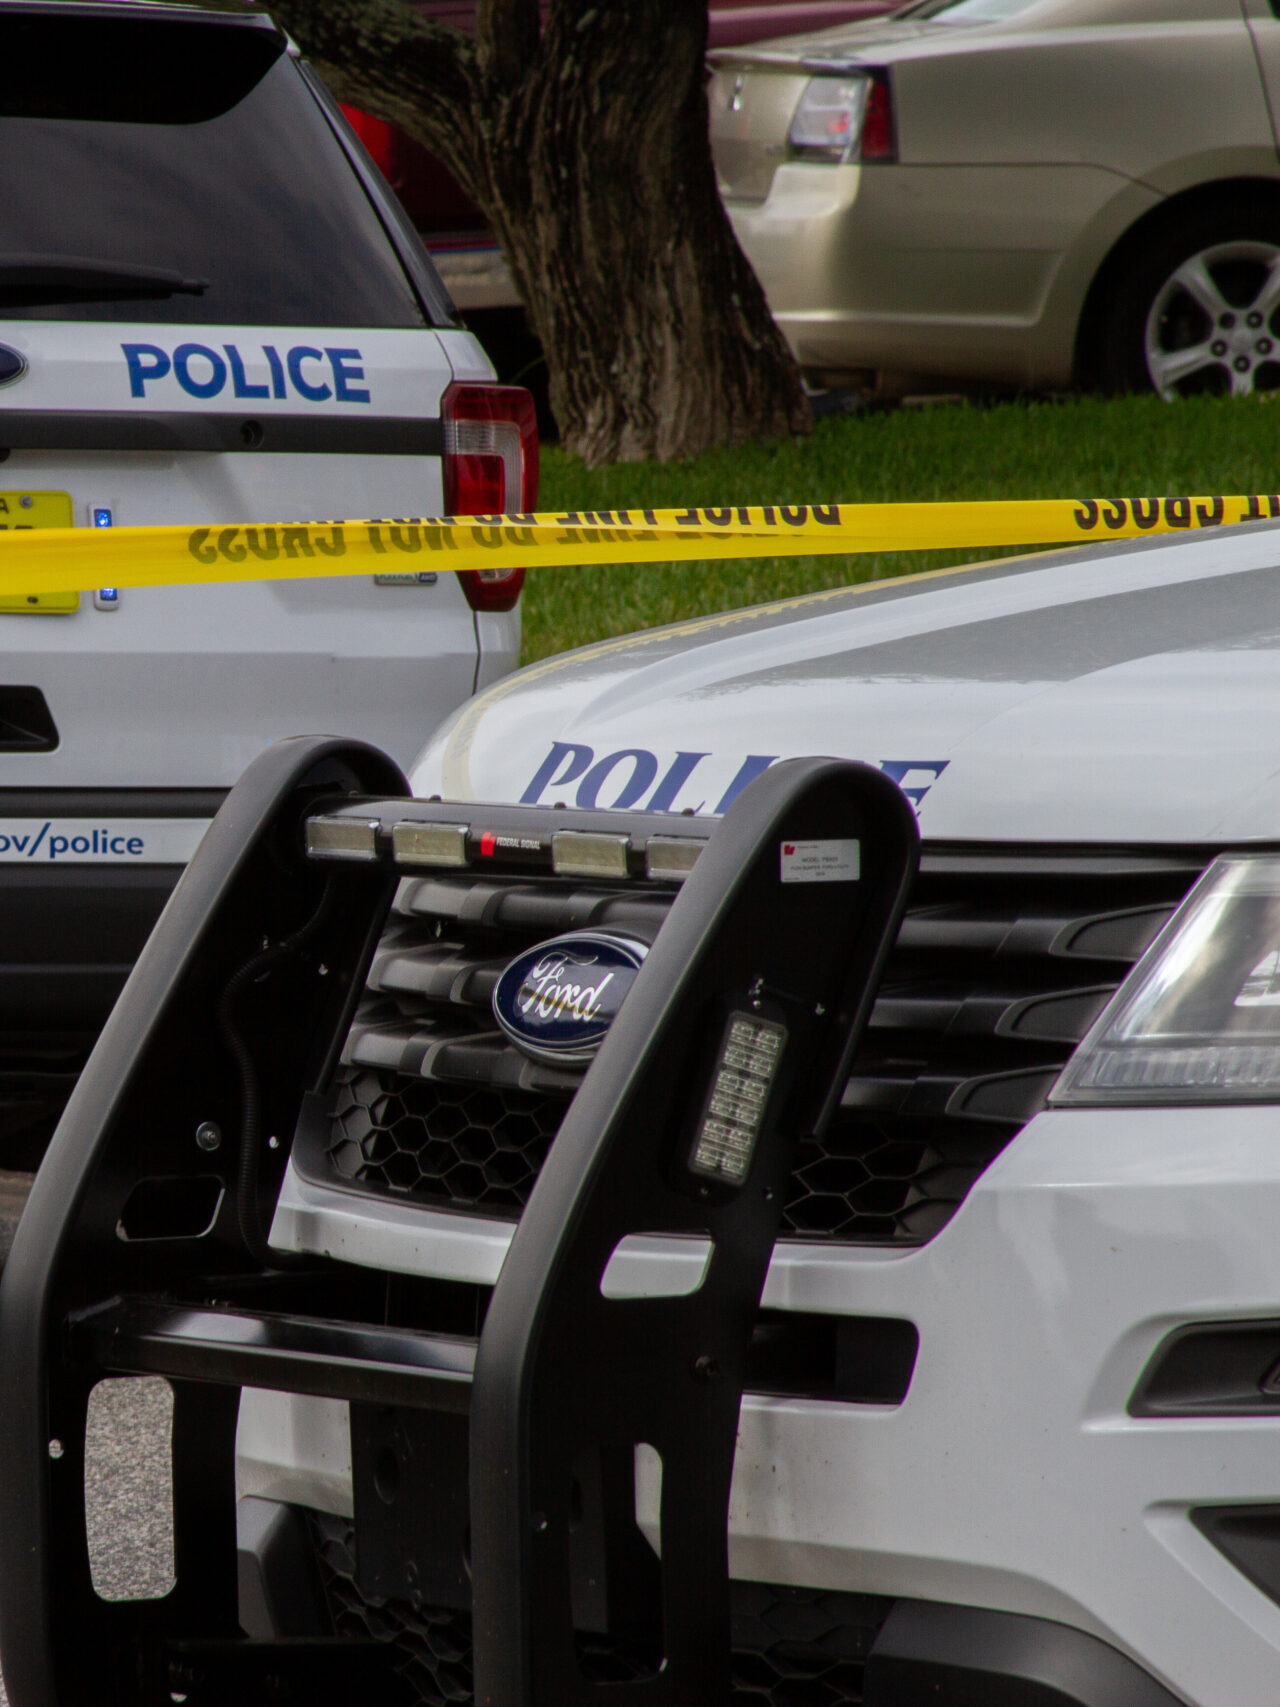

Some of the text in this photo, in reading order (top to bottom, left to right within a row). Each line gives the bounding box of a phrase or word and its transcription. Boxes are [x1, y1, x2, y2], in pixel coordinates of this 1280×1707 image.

[120, 343, 371, 403] POLICE
[519, 741, 951, 815] POLIE
[518, 951, 615, 1022] Ford
